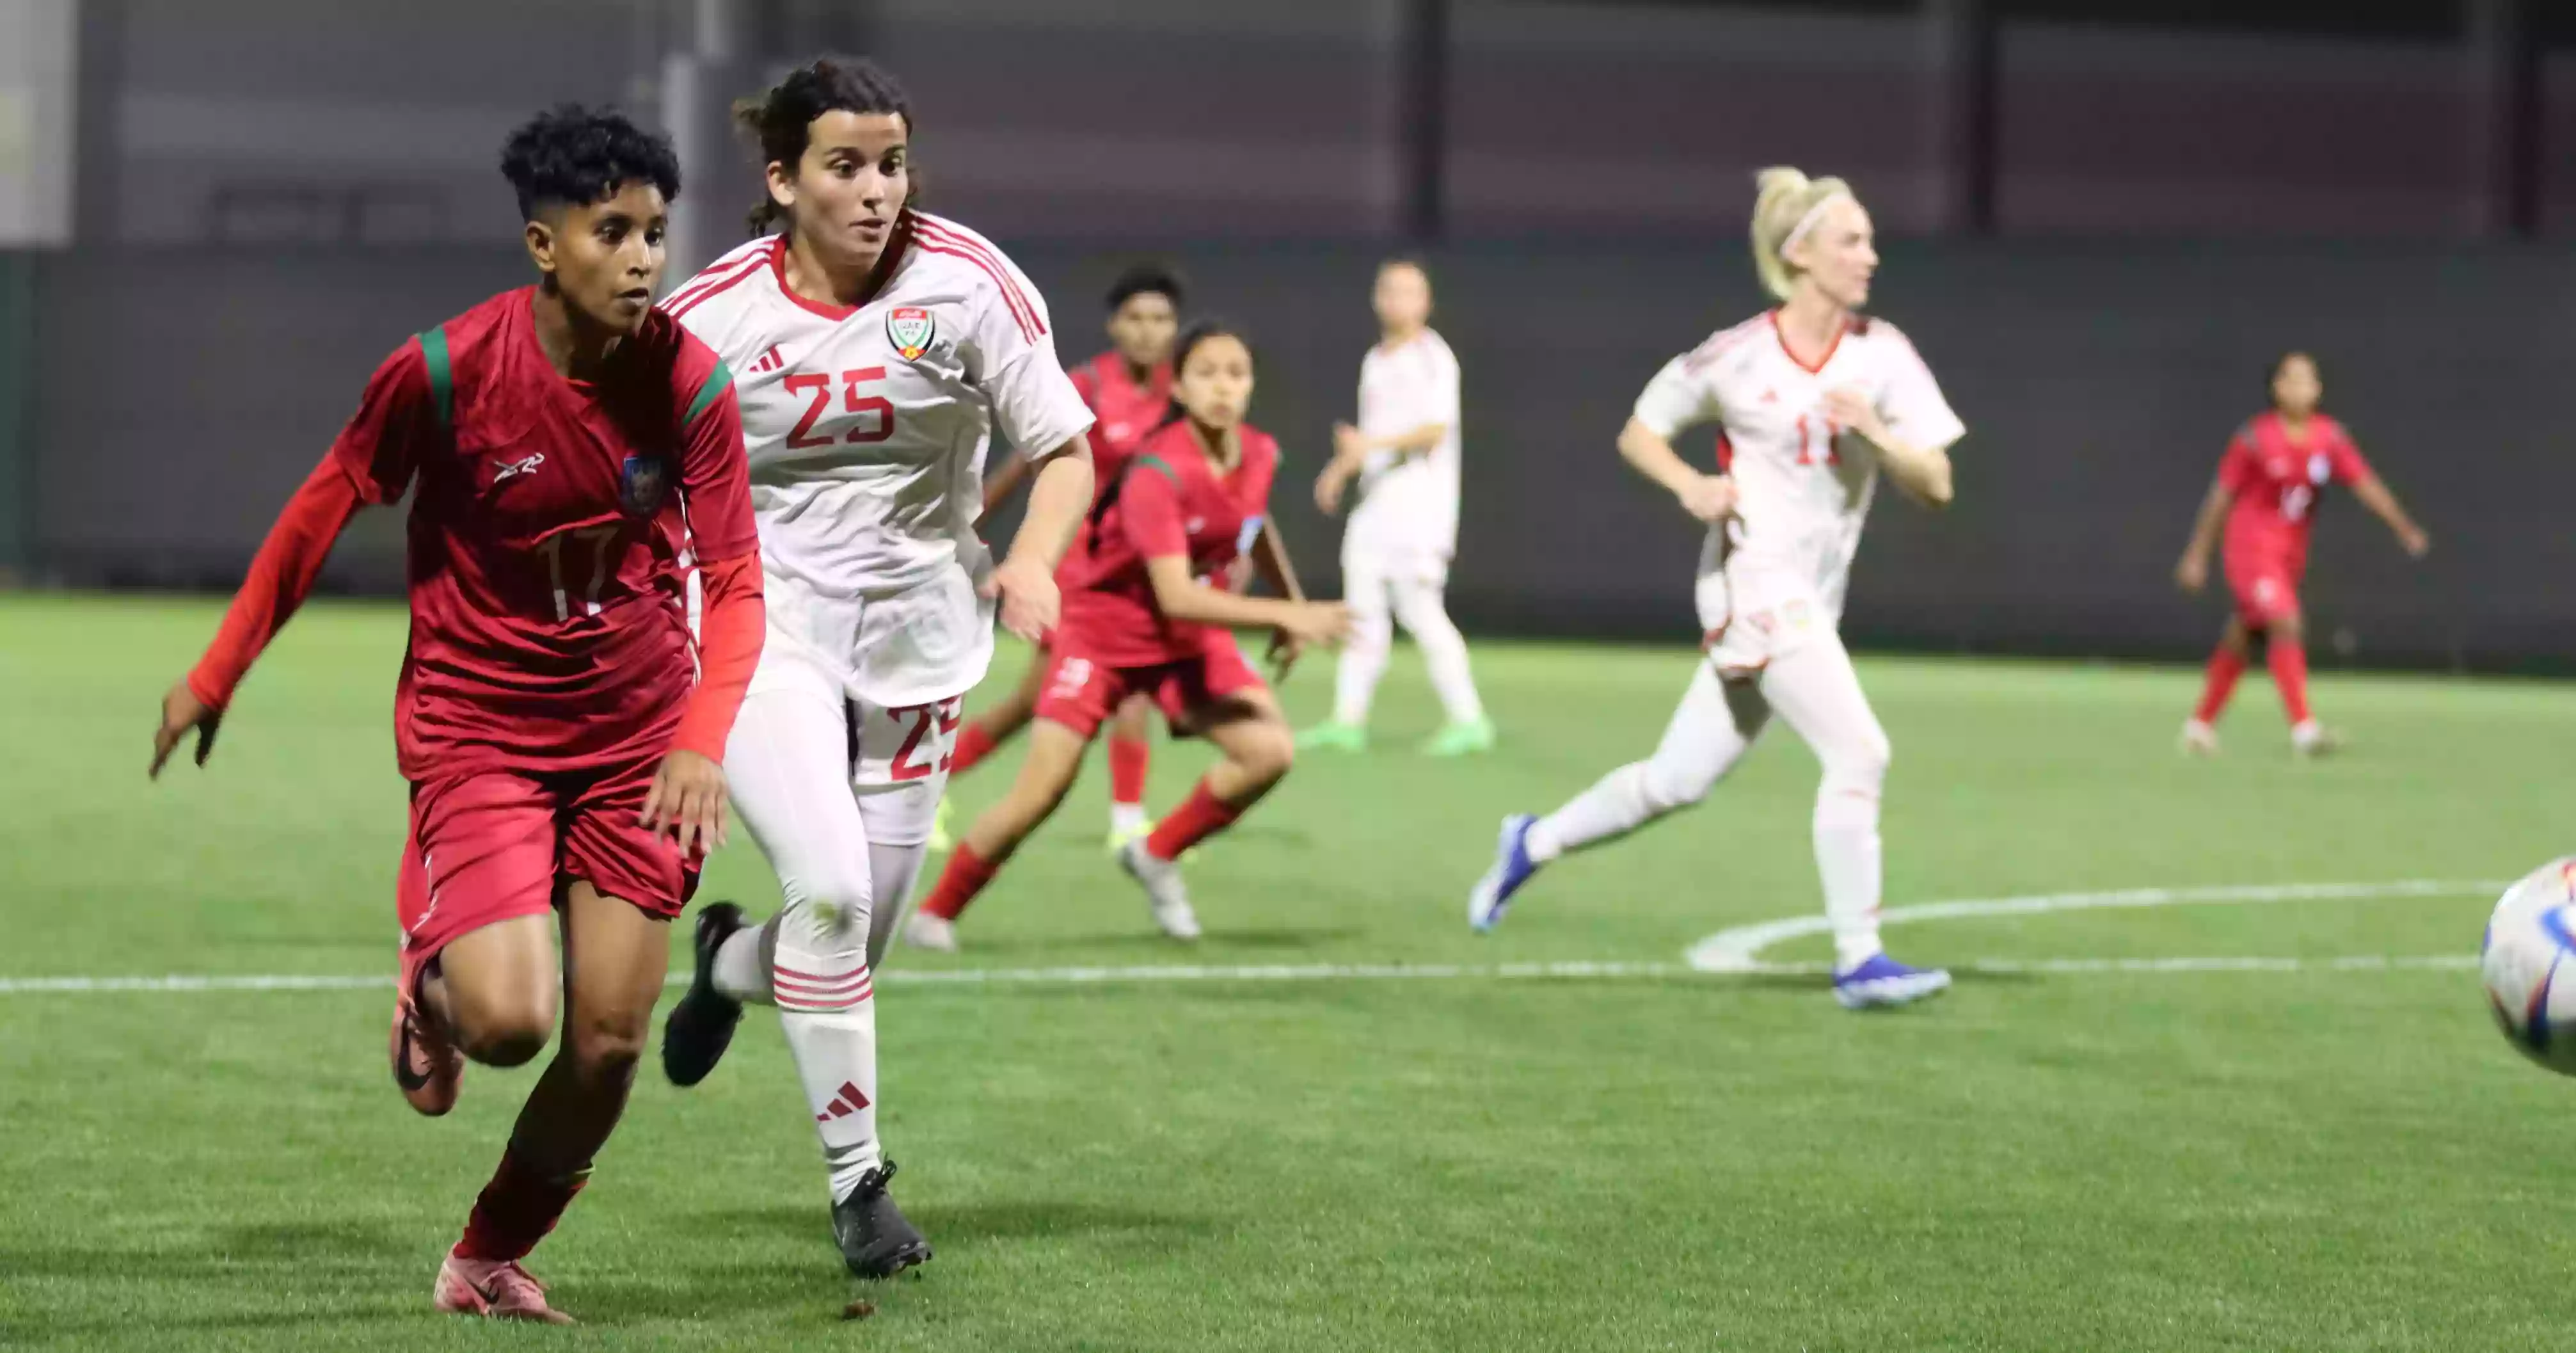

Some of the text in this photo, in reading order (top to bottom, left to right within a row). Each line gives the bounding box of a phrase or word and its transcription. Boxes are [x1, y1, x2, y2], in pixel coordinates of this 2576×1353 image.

[784, 365, 894, 449] 25
[1795, 413, 1842, 466] 11
[535, 525, 621, 623] 17
